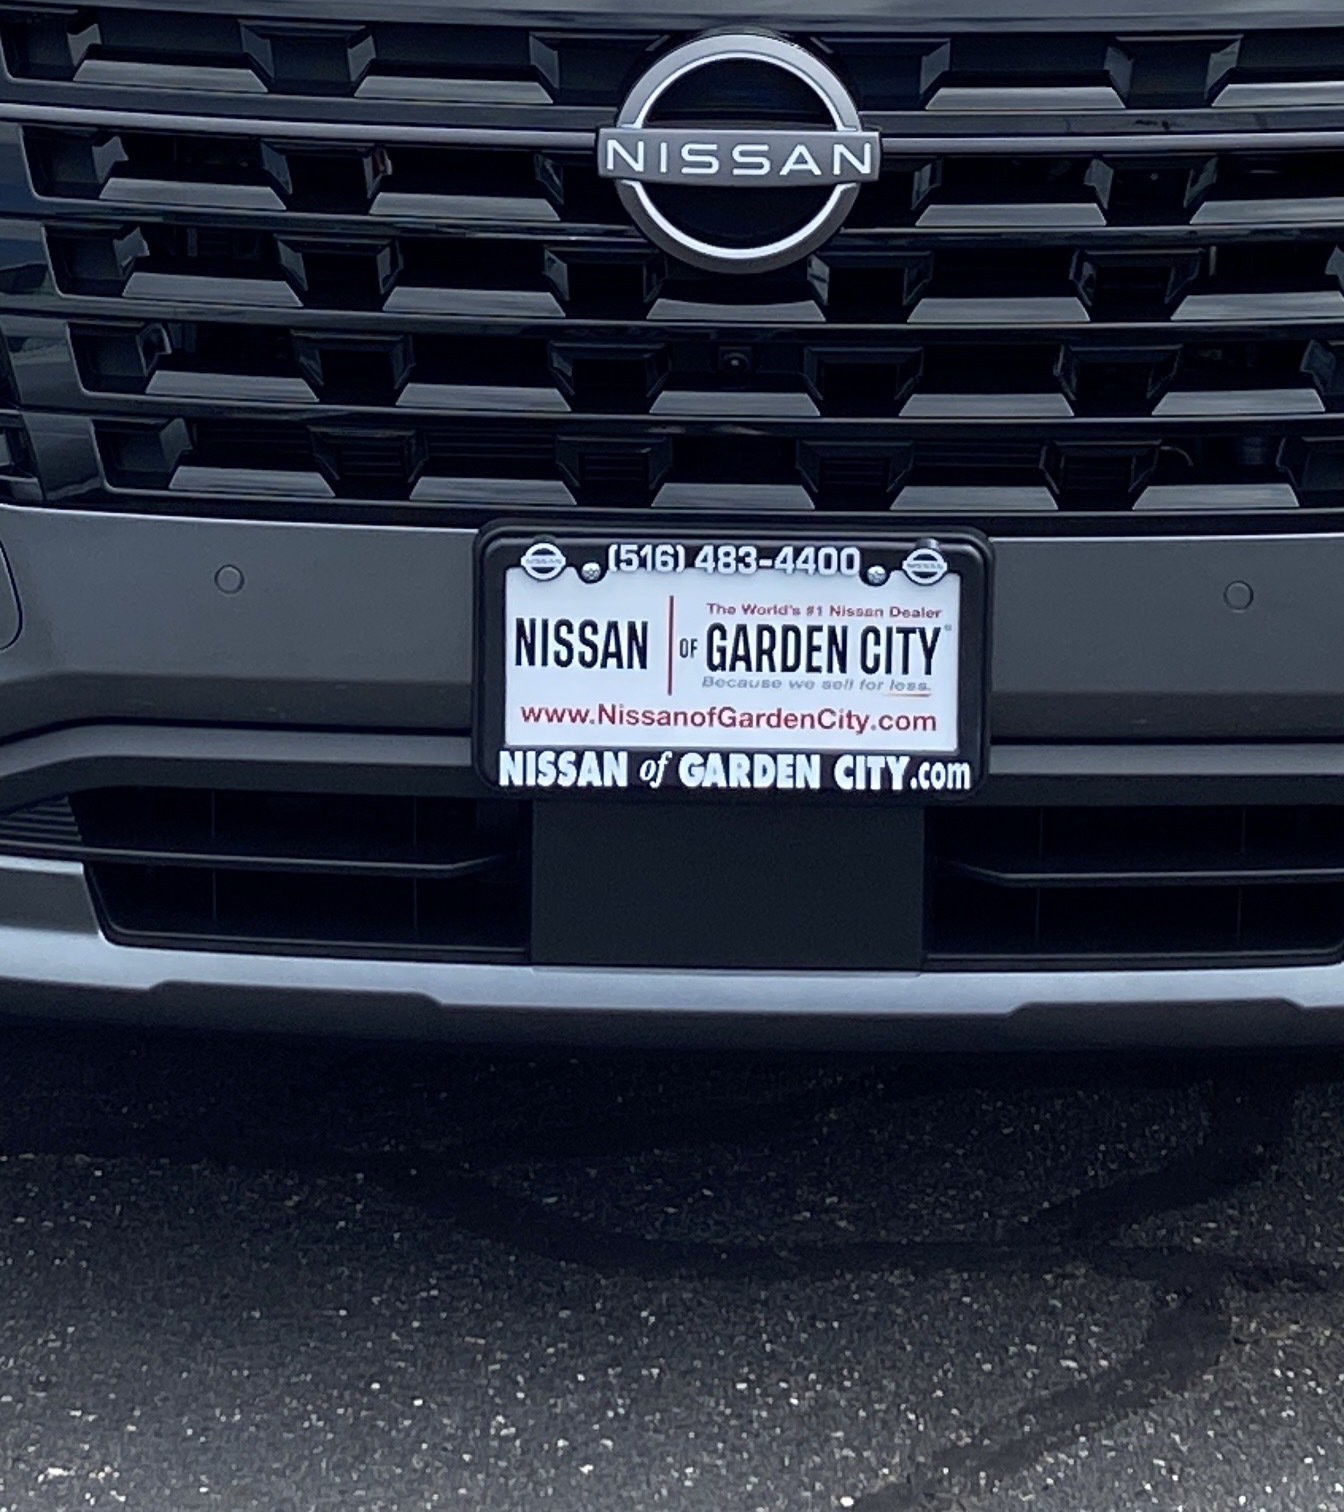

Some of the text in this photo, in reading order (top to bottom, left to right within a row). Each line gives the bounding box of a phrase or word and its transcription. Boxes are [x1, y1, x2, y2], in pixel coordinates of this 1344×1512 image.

[606, 138, 872, 176] NISSAN
[608, 543, 860, 576] (516) 483-4400
[706, 603, 736, 616] The
[742, 603, 801, 617] World's
[829, 605, 884, 618] Nissan
[889, 606, 942, 619] Dealer
[514, 617, 942, 676] NISSAN OF GARDEN CITY
[702, 675, 782, 690] Because
[789, 678, 814, 690] we
[859, 677, 884, 691] for
[521, 703, 936, 735] www.NissanofGardenCity.com
[498, 750, 971, 791] NISSAN of GARDEN CITY.com
